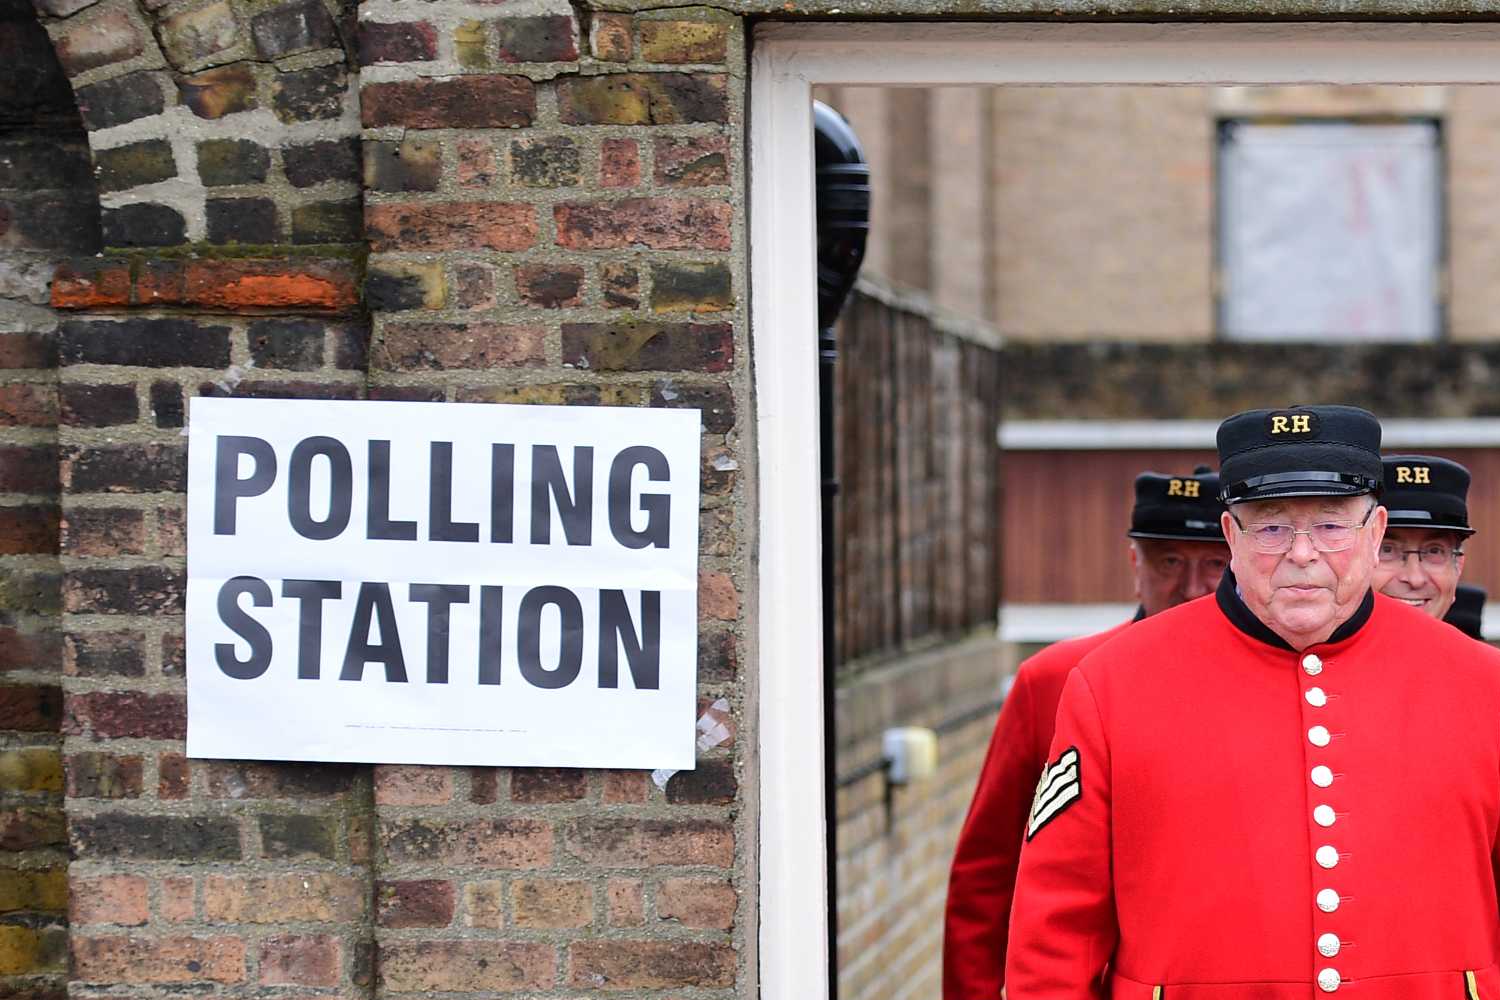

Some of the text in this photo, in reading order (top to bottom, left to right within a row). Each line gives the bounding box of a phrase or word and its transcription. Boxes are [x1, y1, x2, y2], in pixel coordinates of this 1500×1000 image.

[1271, 414, 1311, 434] RH
[1396, 466, 1431, 484] RH
[213, 435, 671, 549] POLLING
[1167, 478, 1200, 498] RH
[214, 575, 661, 690] STATION
